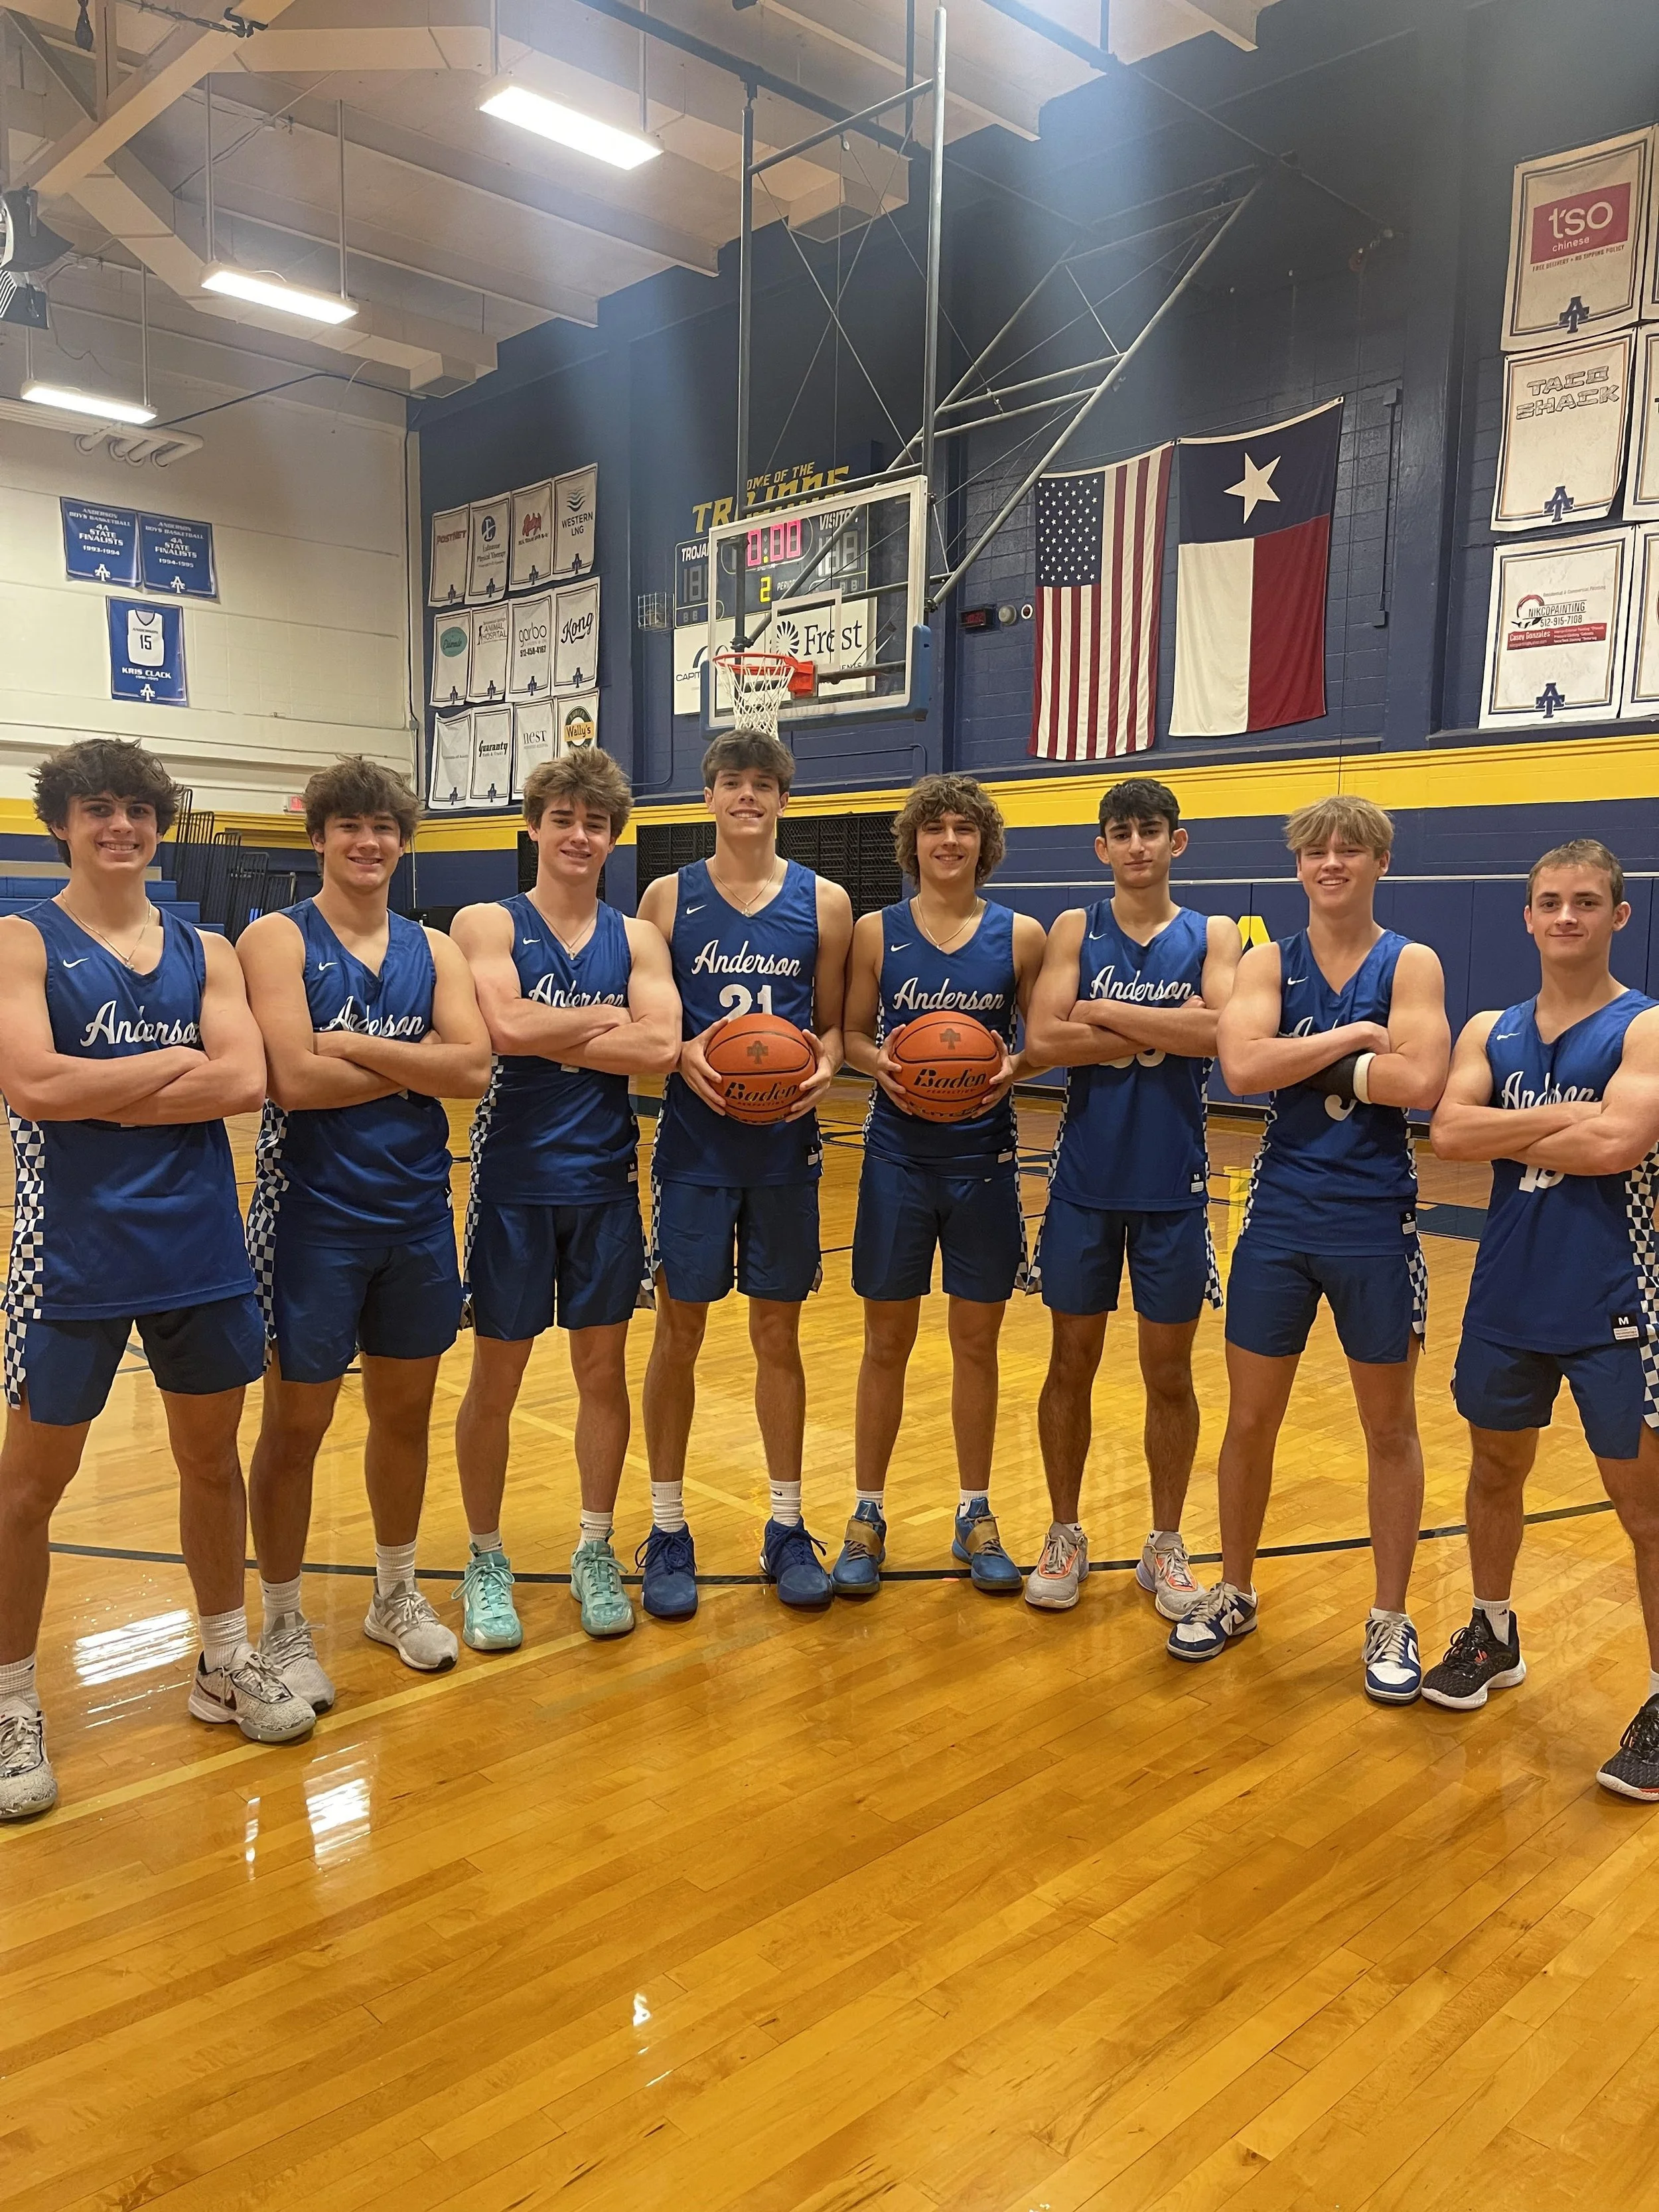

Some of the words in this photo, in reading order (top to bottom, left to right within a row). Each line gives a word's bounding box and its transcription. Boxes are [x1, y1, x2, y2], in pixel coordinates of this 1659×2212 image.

[1552, 236, 1590, 252] chinese
[1546, 258, 1569, 269] DELIVERY
[1583, 250, 1605, 260] TIPPING
[1606, 244, 1625, 254] POLICY
[1526, 365, 1609, 396] TACO
[1516, 384, 1620, 420] SHACK
[747, 473, 774, 491] OME
[774, 469, 789, 483] OF
[792, 461, 816, 478] THE
[69, 511, 88, 520] BOYS
[89, 515, 131, 527] BASKETBALL
[82, 508, 118, 519] ANDERSON
[561, 512, 593, 529] WESTERN
[89, 528, 117, 538] STATE
[158, 522, 192, 532] ANDERSON
[164, 529, 204, 540] BASKETBALL
[571, 525, 584, 536] LNG
[79, 532, 123, 546] FINALISTS
[164, 542, 190, 552] STATE
[82, 545, 120, 555] 1993-1994
[155, 546, 197, 558] FINALISTS
[760, 575, 771, 603] 2
[1528, 601, 1585, 618] NIKCOPAINTING
[484, 621, 504, 632] ANIMAL
[561, 612, 594, 644] Kong
[1540, 615, 1583, 627] 512-915-7108
[139, 634, 152, 650] 15
[482, 628, 508, 641] HOSPITAL
[518, 622, 547, 648] garbo
[1509, 633, 1525, 642] Casey
[1526, 630, 1551, 640] Gonzales
[121, 666, 143, 676] KRIS
[145, 670, 172, 680] CLACK
[566, 724, 591, 738] Wally's
[478, 739, 508, 757] Guaranty
[691, 939, 802, 978] Anderson
[1090, 964, 1195, 1002] Anderson
[892, 976, 1006, 1011] Anderson
[719, 983, 773, 1023] 21
[914, 1068, 987, 1088] Baden
[724, 1081, 798, 1102] Baden
[1406, 1213, 1411, 1221] S
[1618, 1316, 1629, 1326] M
[859, 1504, 872, 1520] 4
